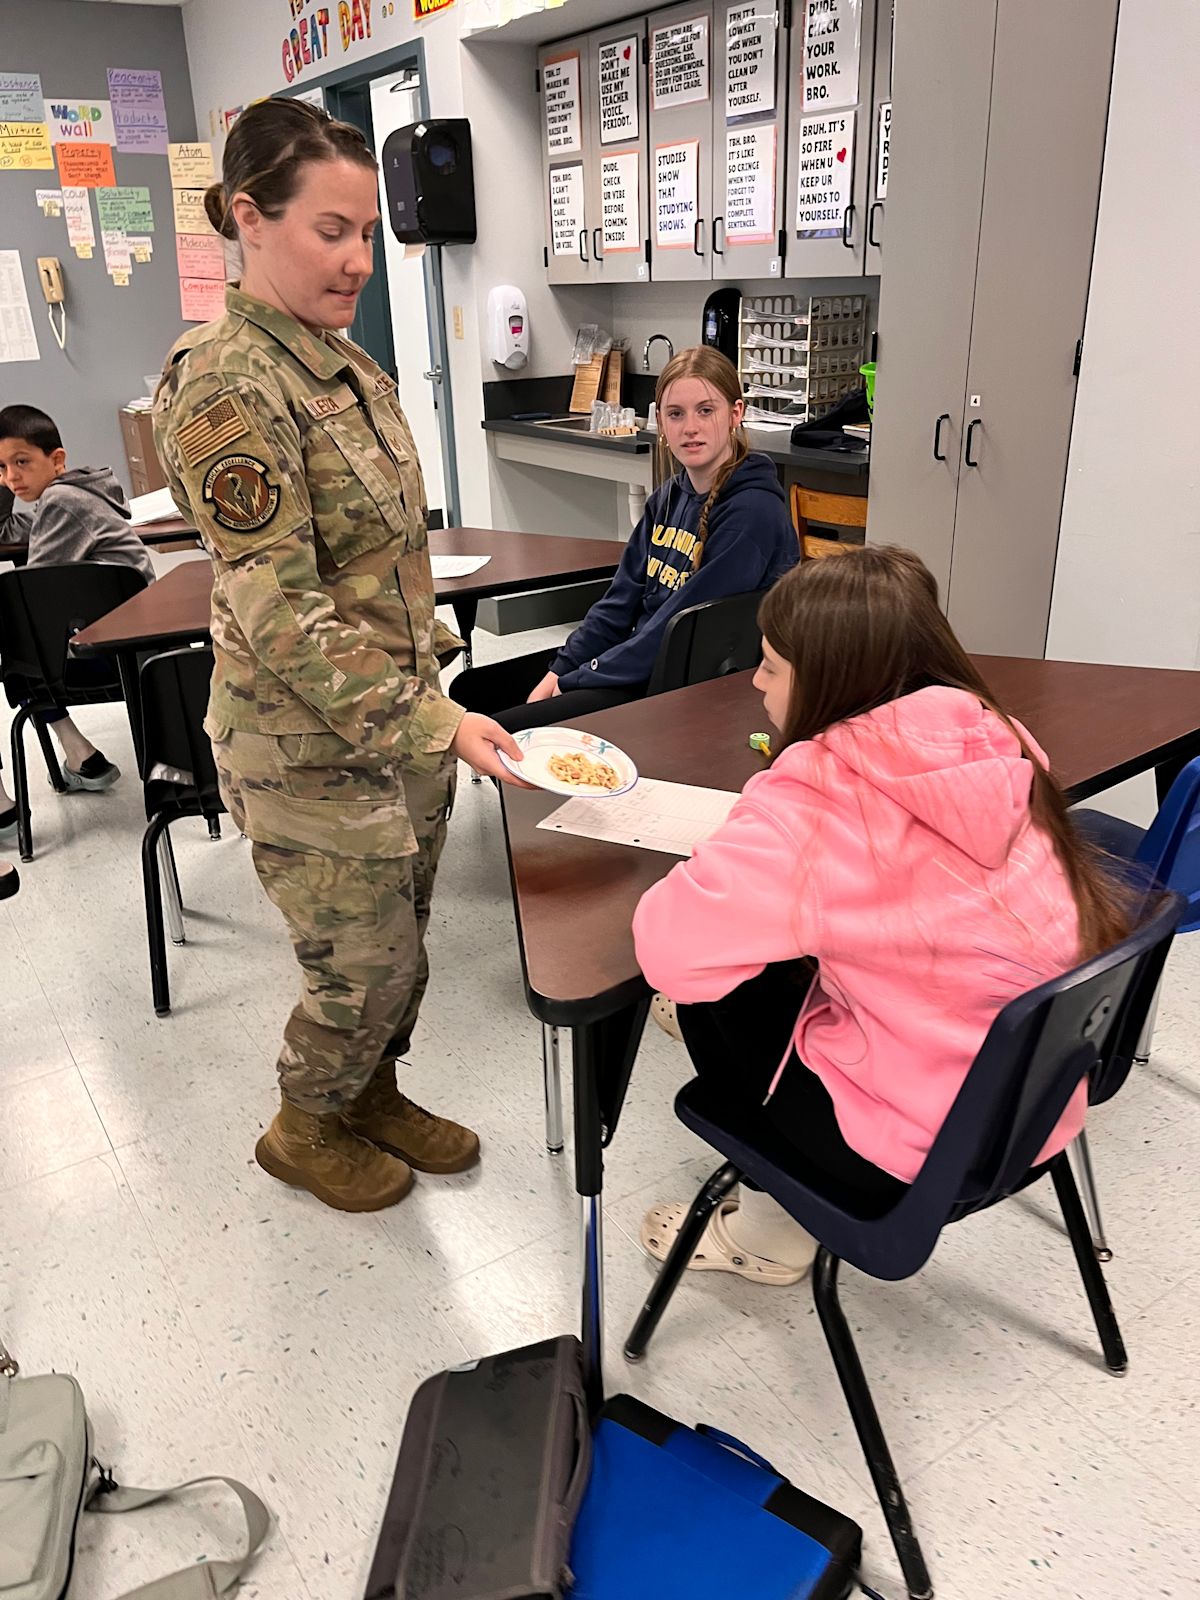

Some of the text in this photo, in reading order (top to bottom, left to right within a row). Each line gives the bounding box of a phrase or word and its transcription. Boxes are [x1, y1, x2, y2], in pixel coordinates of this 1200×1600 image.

[743, 8, 755, 17] IT'S
[282, 0, 371, 83] GREAT DAY
[742, 35, 761, 48] WHEN
[807, 41, 834, 59] YOUR
[728, 49, 763, 65] YOU DON'T
[601, 58, 619, 72] DON'T
[806, 61, 840, 79] WORK.
[601, 67, 629, 83] MAKE ME
[728, 65, 757, 79] CLEAN UP
[602, 81, 623, 95] USE MY
[728, 82, 747, 93] AFTER
[807, 85, 829, 101] BRO.
[602, 91, 628, 106] TEACHER
[51, 105, 102, 122] WORD
[60, 121, 92, 137] wall
[829, 120, 845, 133] IT'S
[179, 145, 202, 157] Atom
[802, 140, 832, 154] SO FIRE
[658, 151, 686, 166] STUDIES
[729, 149, 754, 160] IT'S LIKE
[728, 161, 759, 173] SO CRINGE
[801, 157, 833, 171] WHEN U
[603, 176, 620, 186] CHECK
[659, 169, 679, 183] SHOW
[728, 175, 755, 185] WHEN YOU
[801, 175, 832, 188] KEEP UR
[604, 190, 625, 200] UR VIBE
[659, 187, 675, 199] THAT
[728, 187, 746, 196] FORGET
[728, 198, 744, 207] WRITE
[800, 192, 840, 205] HANDS TO
[604, 204, 624, 214] BEFORE
[659, 201, 693, 215] STUDYING
[728, 209, 754, 218] COMPLETE
[799, 209, 841, 221] YOURSELF.
[605, 218, 627, 227] COMING
[659, 219, 686, 231] SHOWS.
[180, 237, 215, 248] Molecule
[605, 232, 625, 241] INSIDE
[182, 280, 224, 293] Compound
